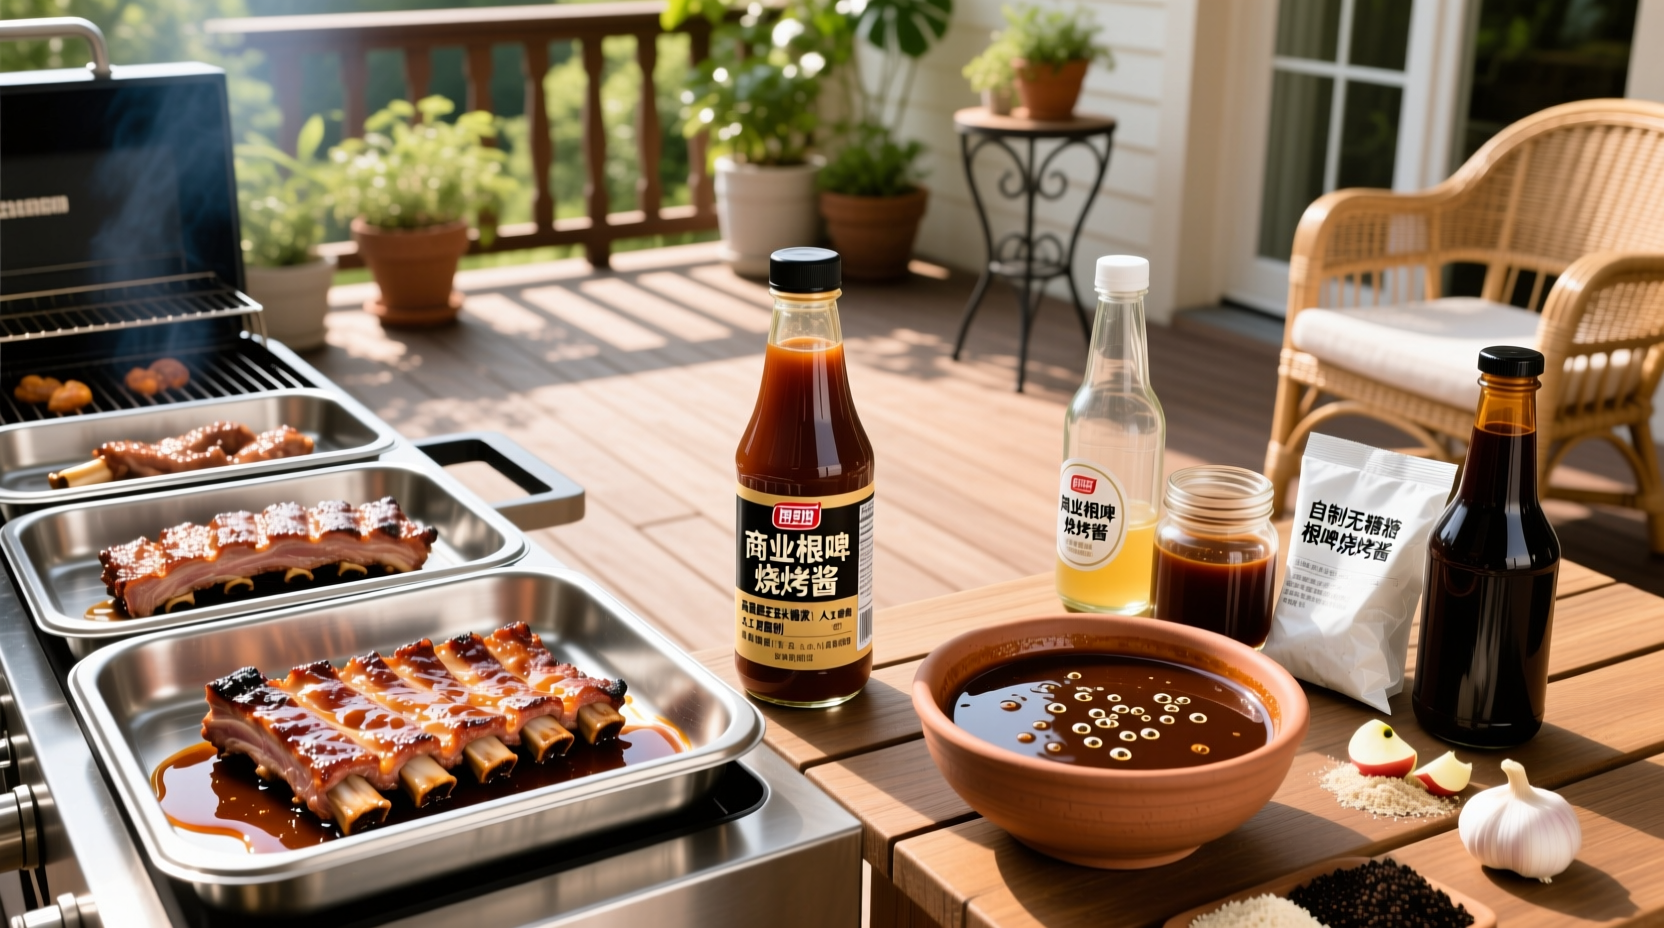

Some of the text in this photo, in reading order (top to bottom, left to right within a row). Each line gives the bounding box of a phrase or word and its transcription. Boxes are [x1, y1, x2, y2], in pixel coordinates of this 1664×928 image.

[745, 529, 850, 563] 商业根啤
[1301, 521, 1392, 562] 根啤烧烤酱
[754, 563, 838, 597] 烧烤酱
